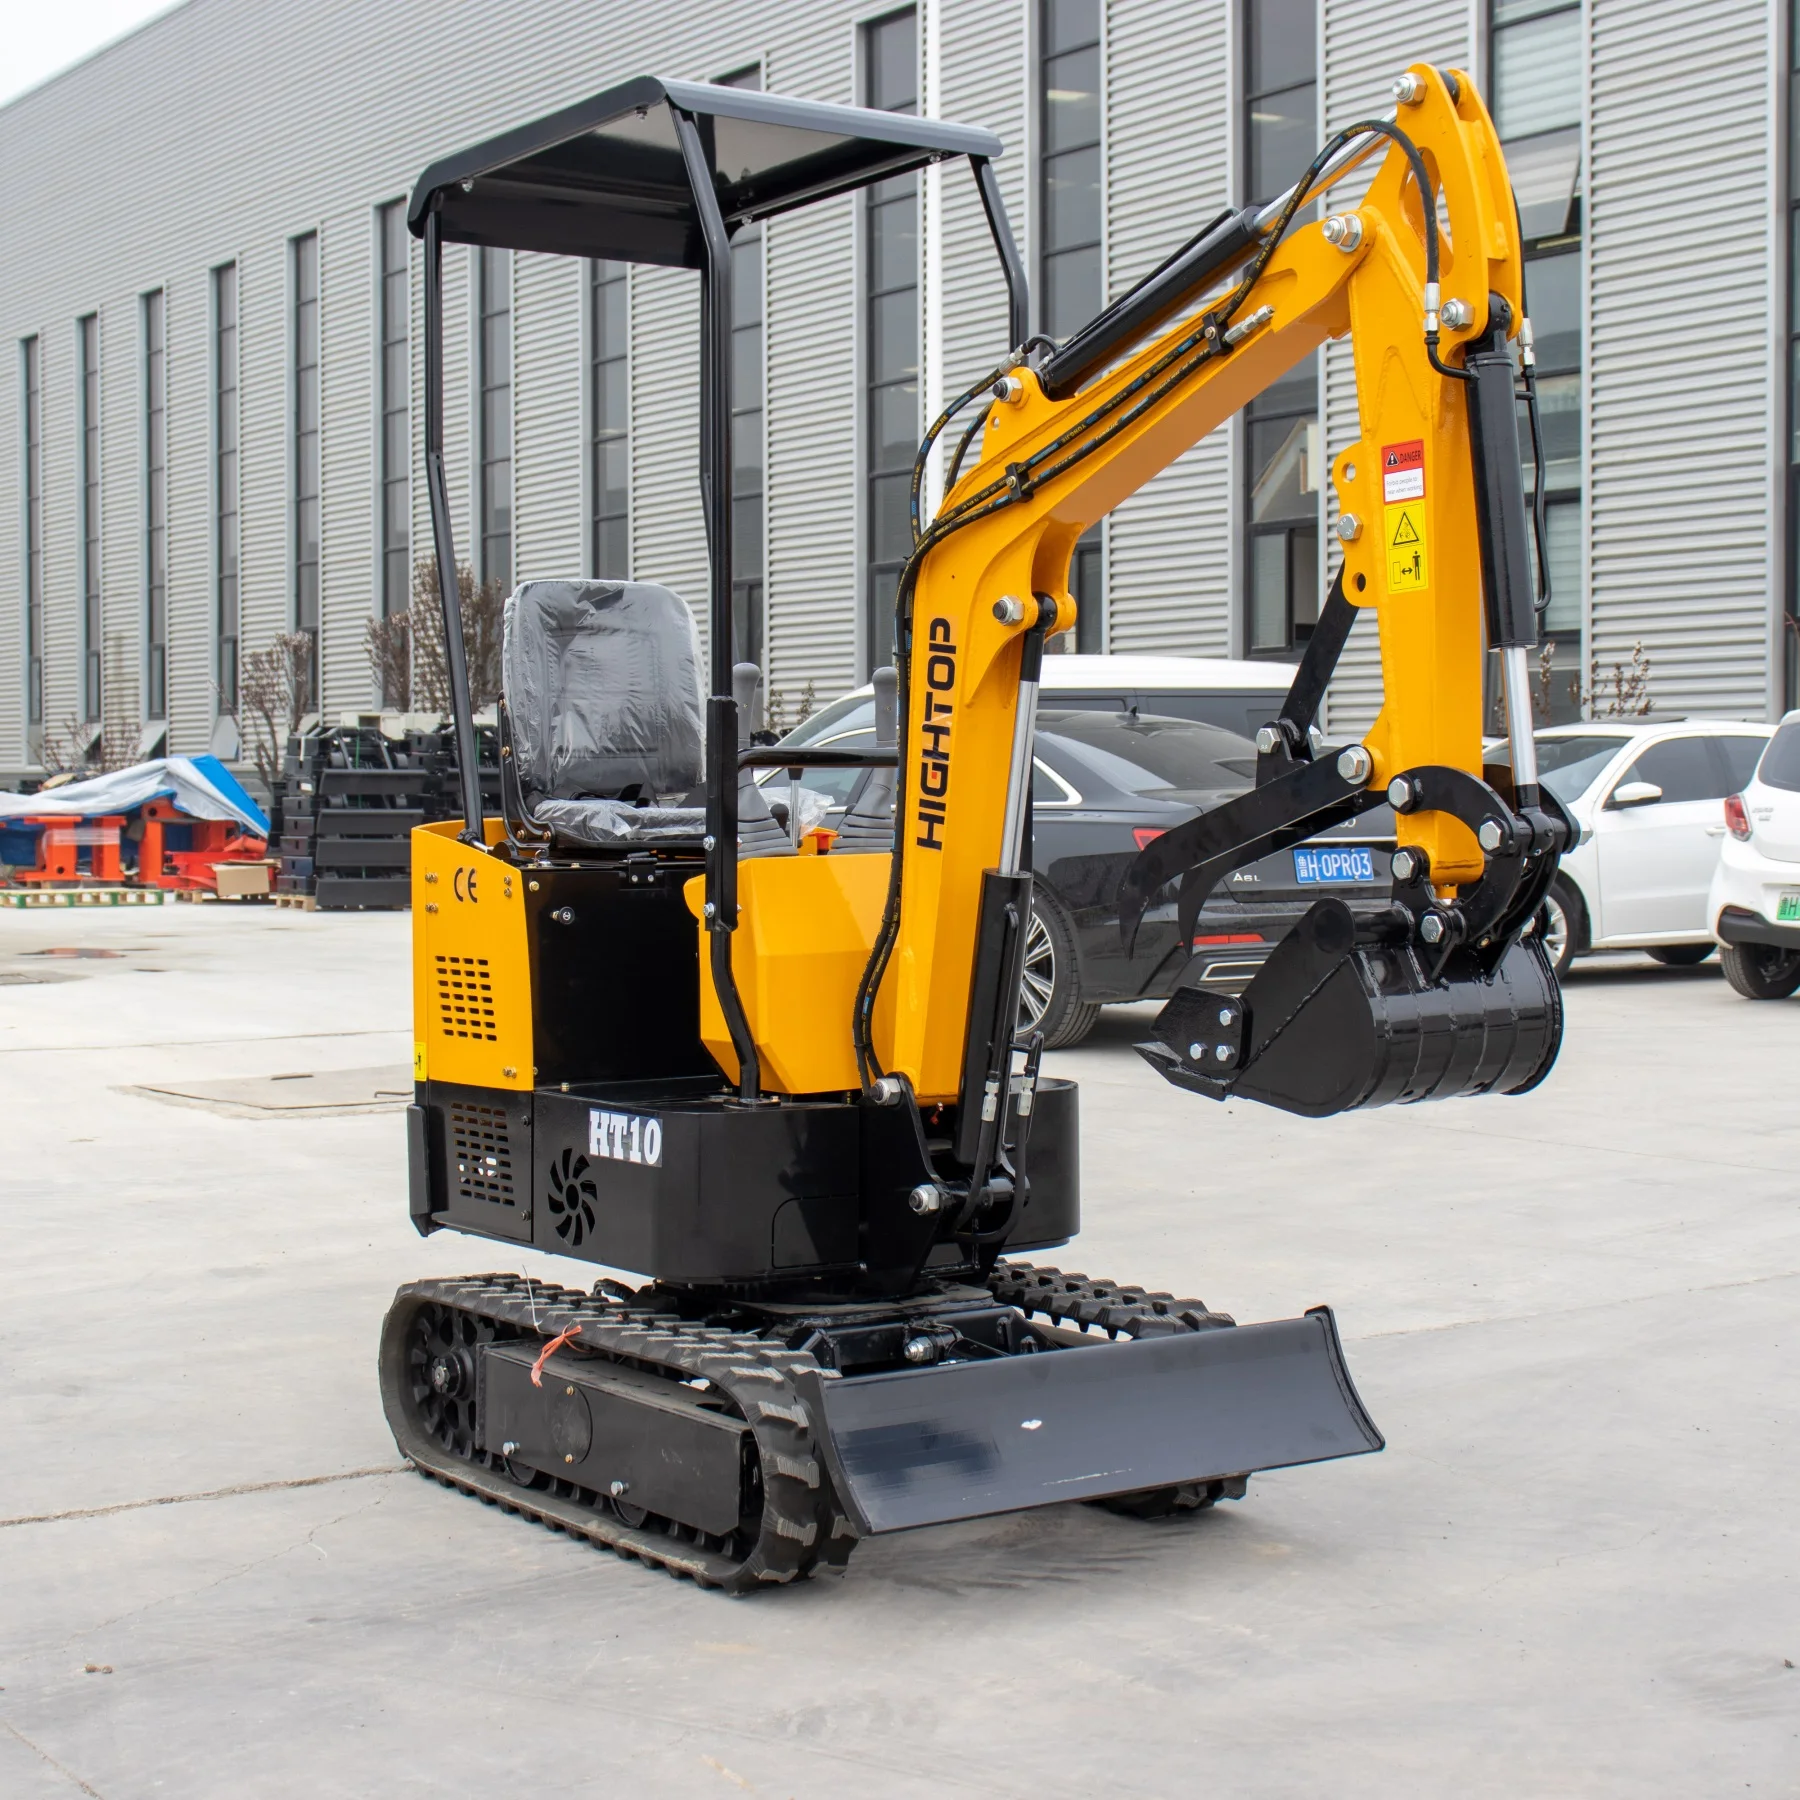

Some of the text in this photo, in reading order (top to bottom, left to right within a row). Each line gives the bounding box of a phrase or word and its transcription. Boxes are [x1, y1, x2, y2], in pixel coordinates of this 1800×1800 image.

[1400, 450, 1421, 463] DANGER
[917, 617, 957, 850] HIGHTOP
[454, 867, 477, 903] CE
[1233, 872, 1261, 882] A6L
[590, 1110, 662, 1165] HT10
